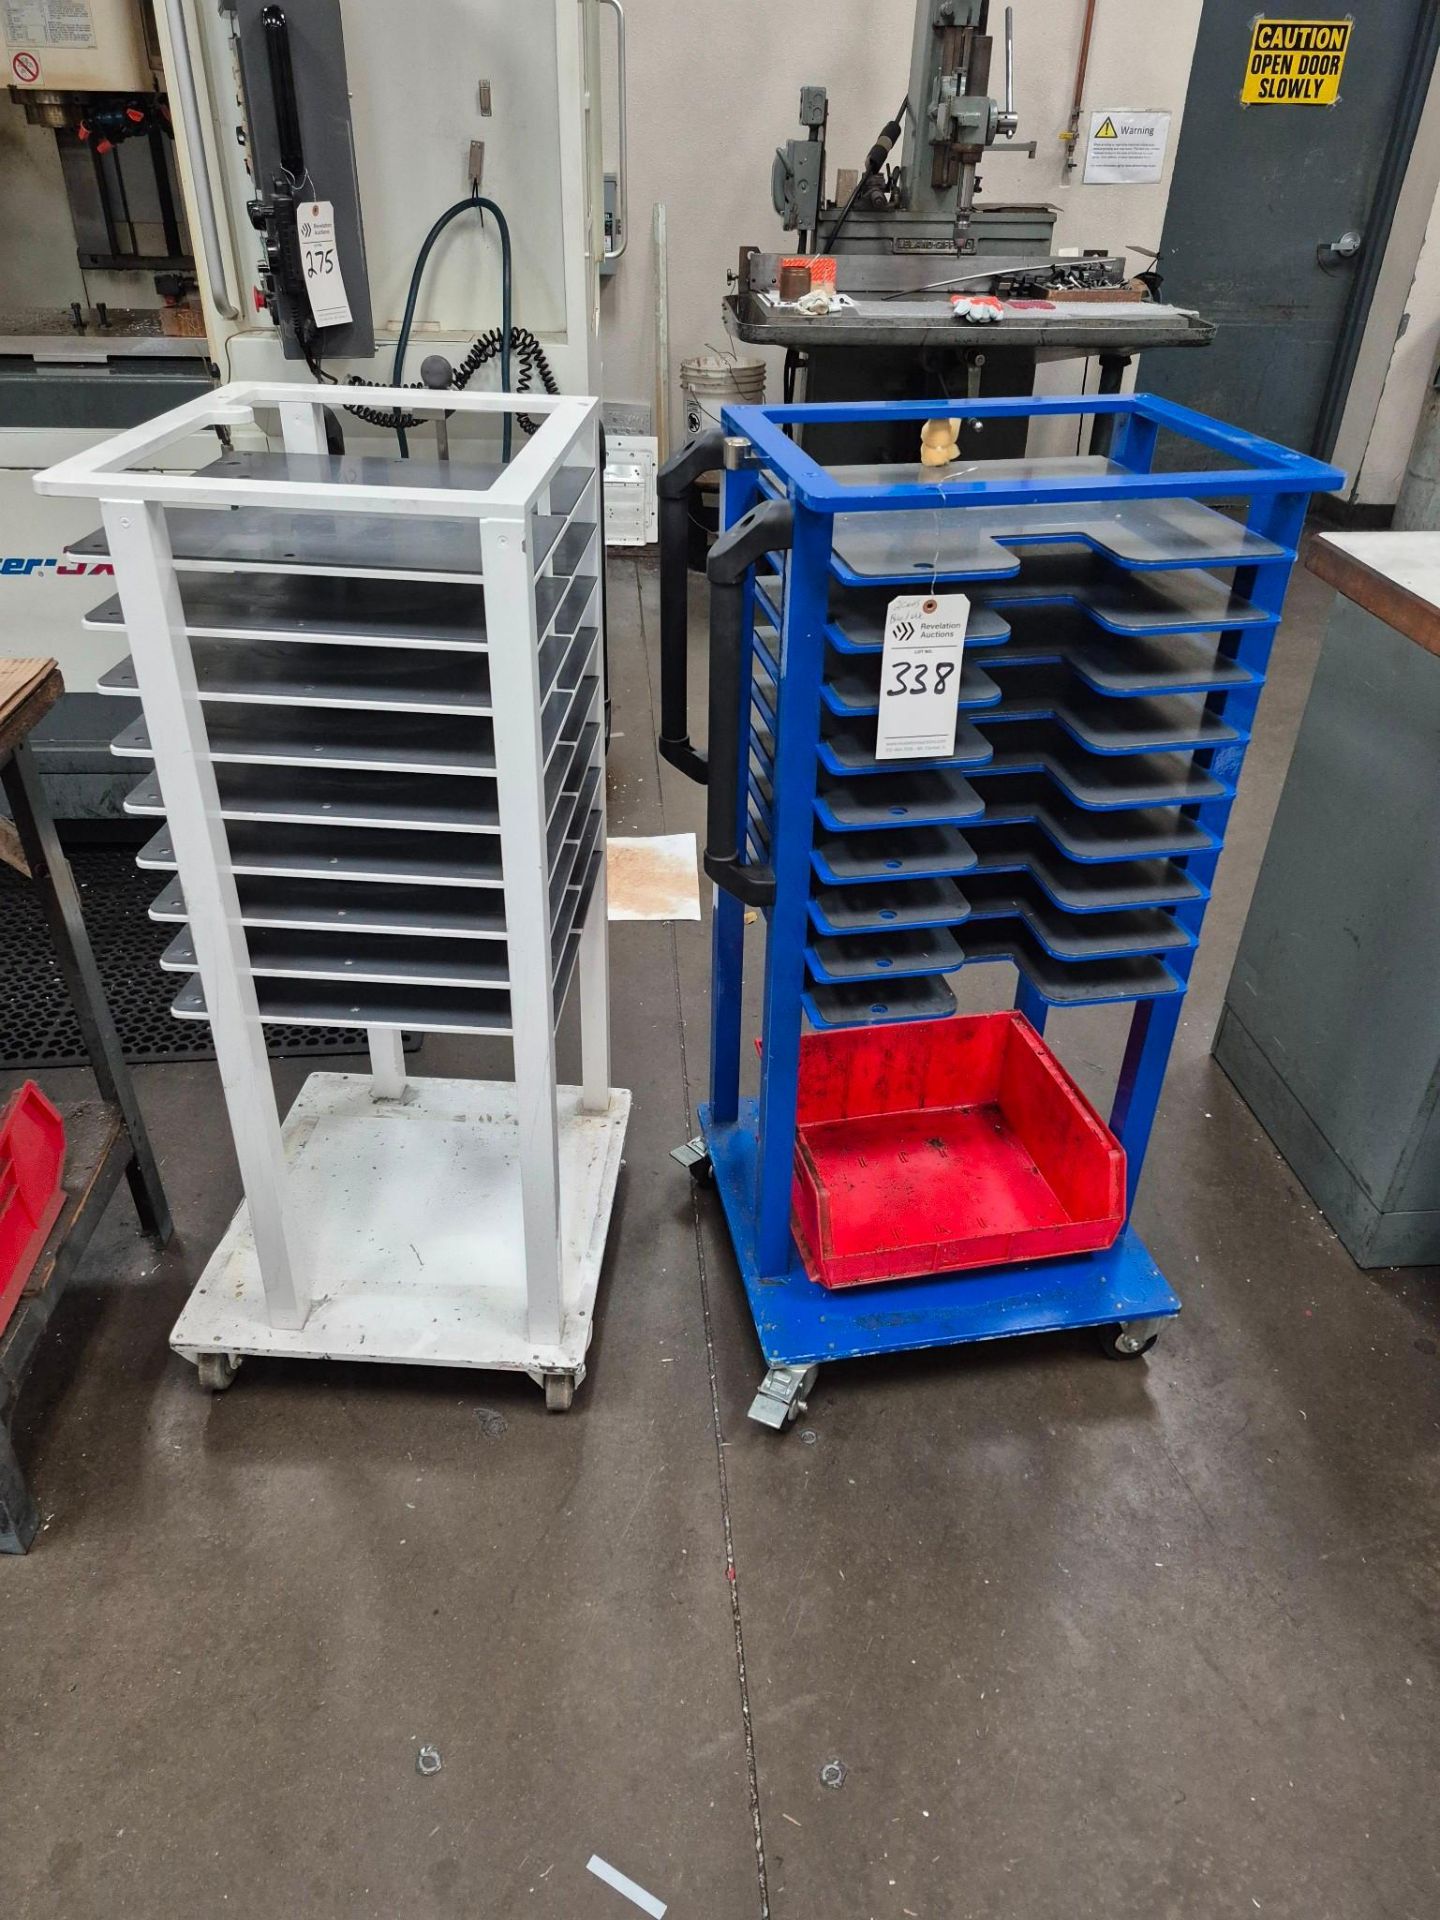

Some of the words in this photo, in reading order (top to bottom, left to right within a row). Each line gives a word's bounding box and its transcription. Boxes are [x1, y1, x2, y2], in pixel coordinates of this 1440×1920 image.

[1258, 26, 1345, 50] CAUTION
[1250, 54, 1294, 75] OPEN
[1297, 54, 1341, 75] DOOR
[1258, 78, 1325, 98] SLOWLY
[1120, 125, 1155, 136] Warning
[306, 249, 334, 278] 275
[920, 622, 961, 630] Revelation
[886, 661, 955, 697] 338
